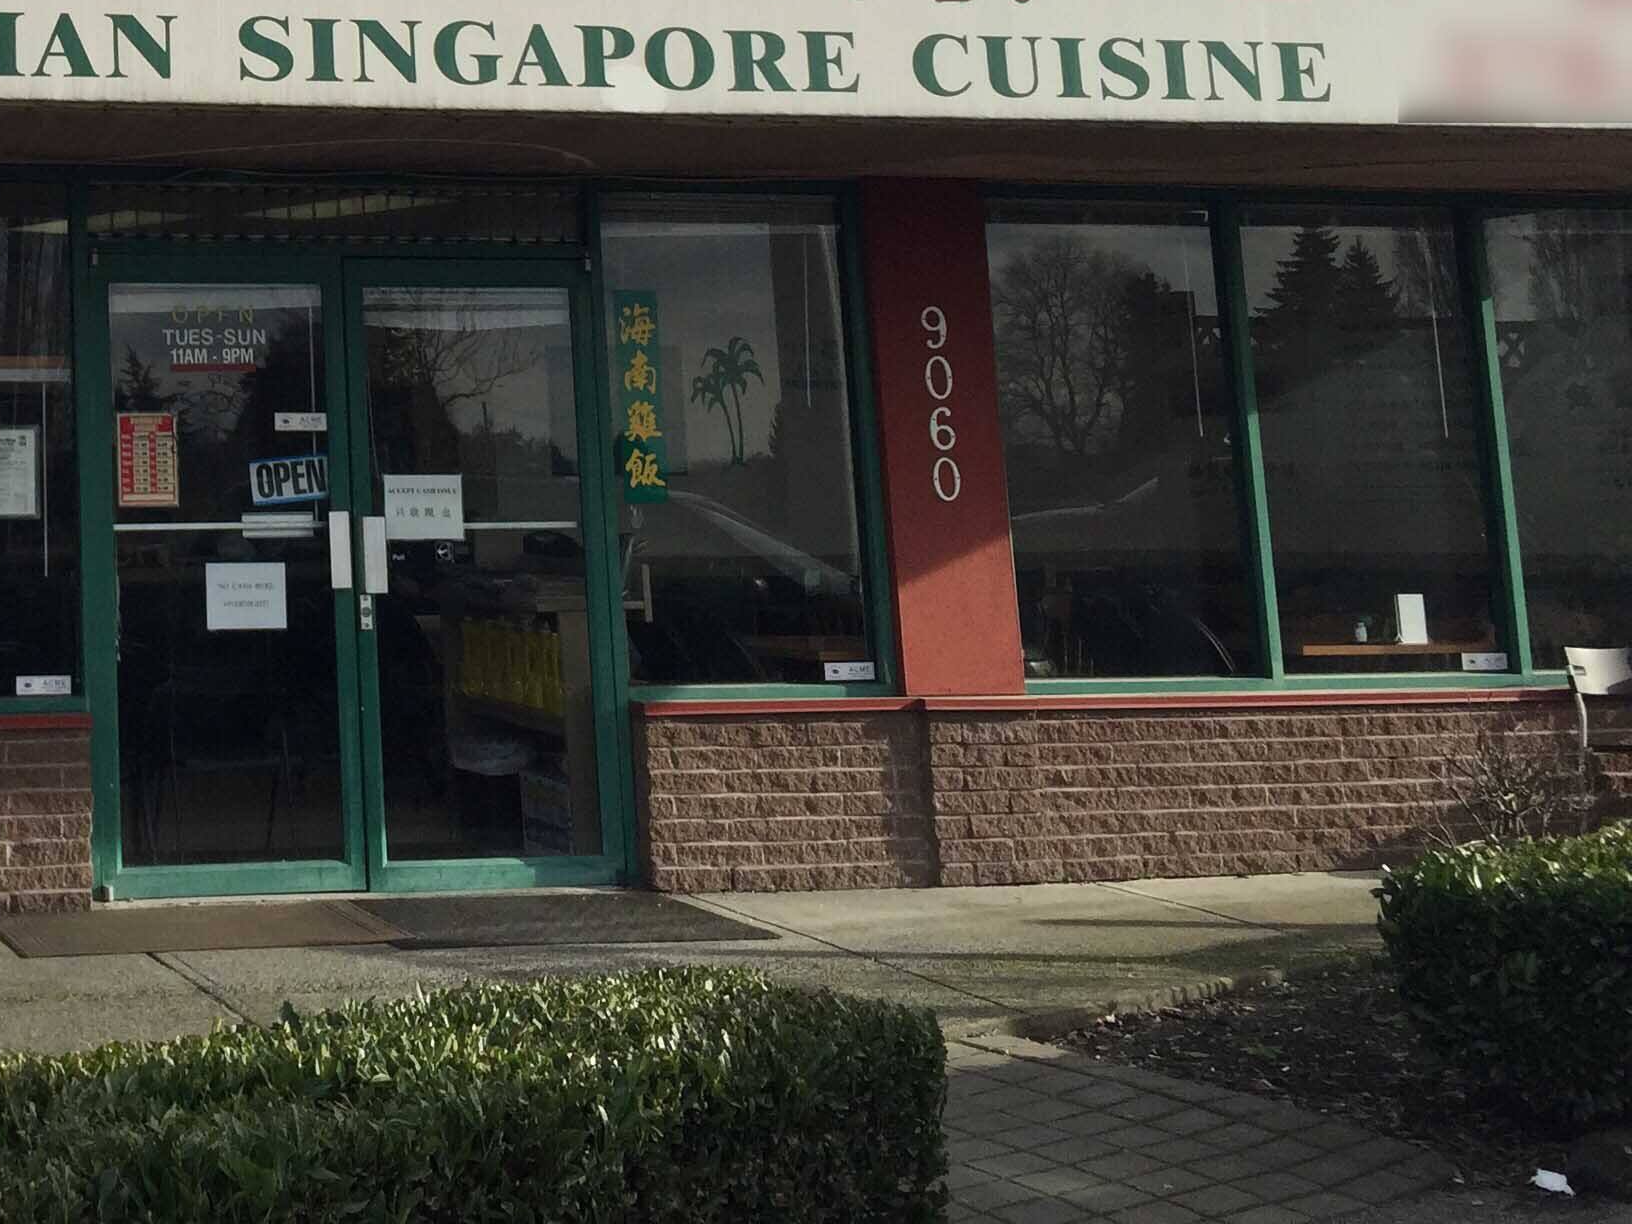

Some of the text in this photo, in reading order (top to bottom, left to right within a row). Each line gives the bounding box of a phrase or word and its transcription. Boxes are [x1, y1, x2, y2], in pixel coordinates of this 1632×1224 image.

[238, 15, 862, 94] SINGAPORE
[911, 32, 1332, 104] CUISINE
[170, 347, 208, 365] 11AM
[222, 347, 255, 365] 9PM
[920, 305, 962, 503] 9060
[255, 457, 327, 499] OPEN
